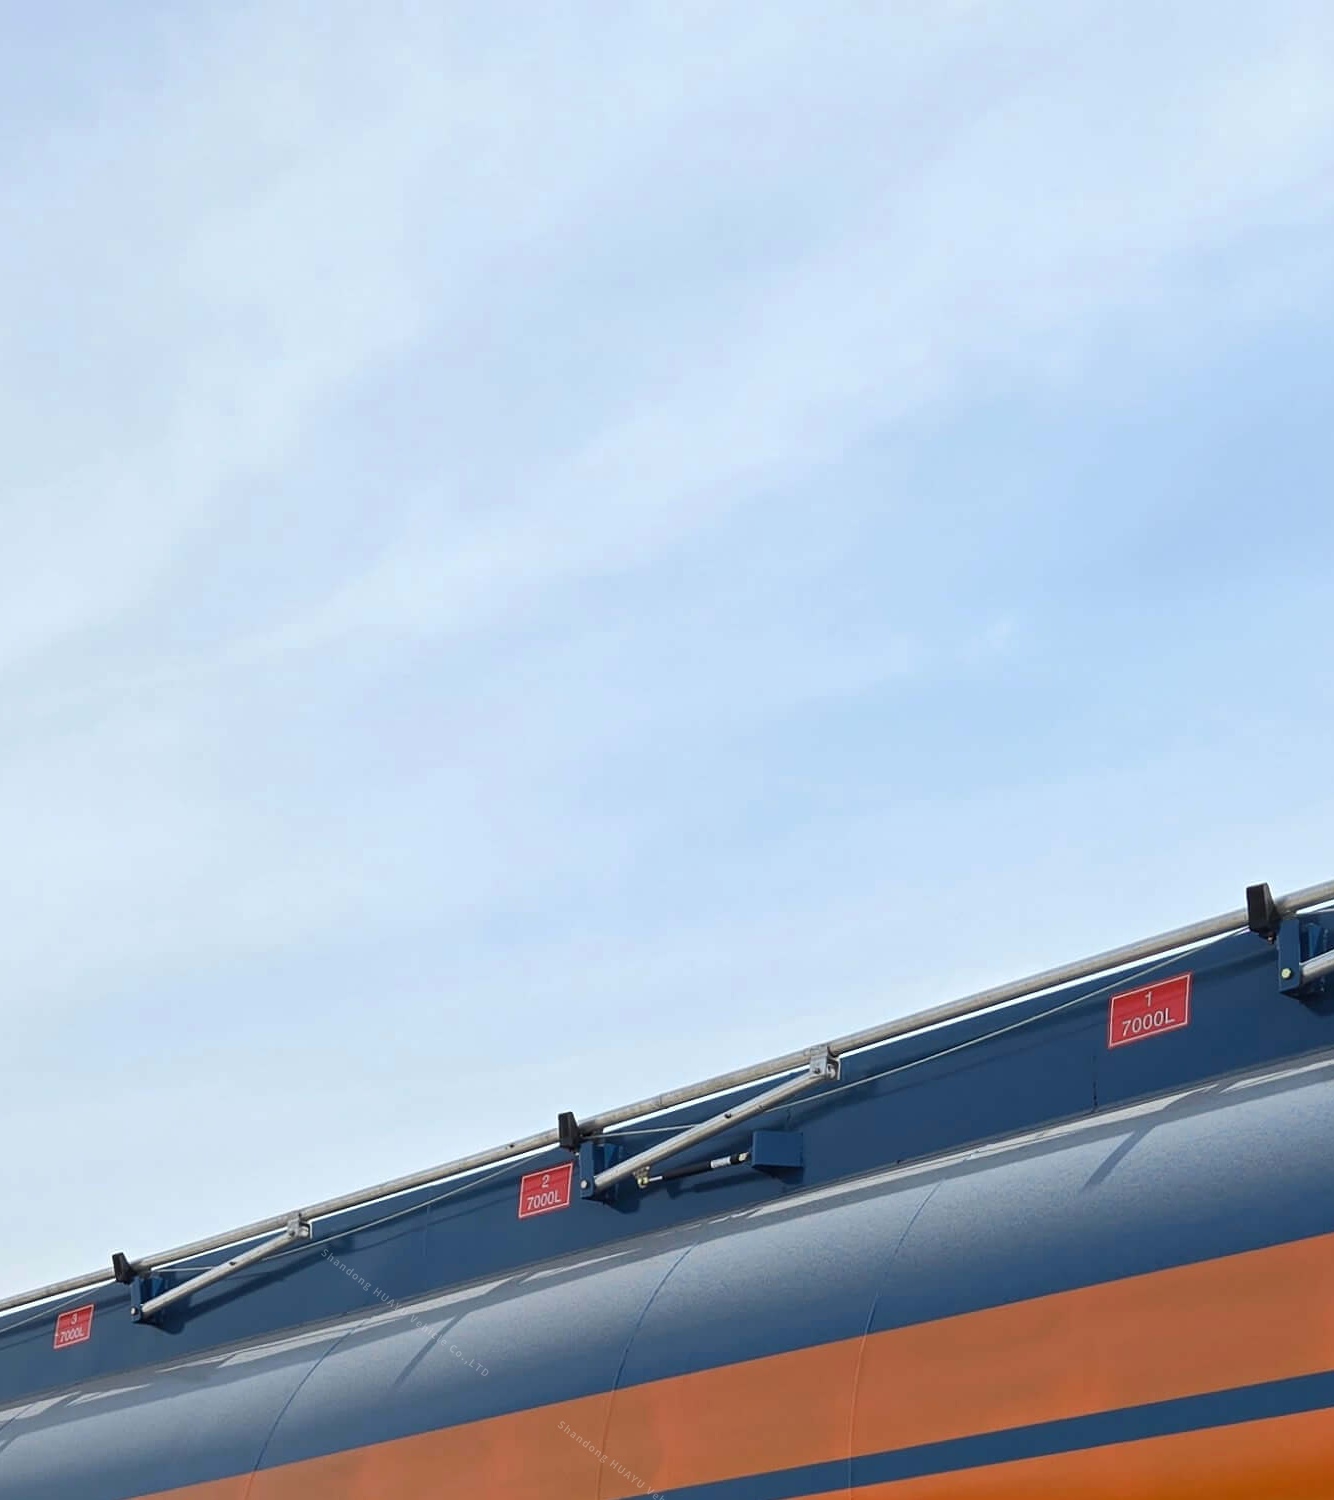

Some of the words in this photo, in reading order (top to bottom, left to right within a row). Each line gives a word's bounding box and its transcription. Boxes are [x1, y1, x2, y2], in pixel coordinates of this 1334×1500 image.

[1144, 991, 1153, 1008] 1
[1122, 1007, 1175, 1037] 7000L
[541, 1174, 550, 1188] 2
[527, 1190, 561, 1211] 7000L
